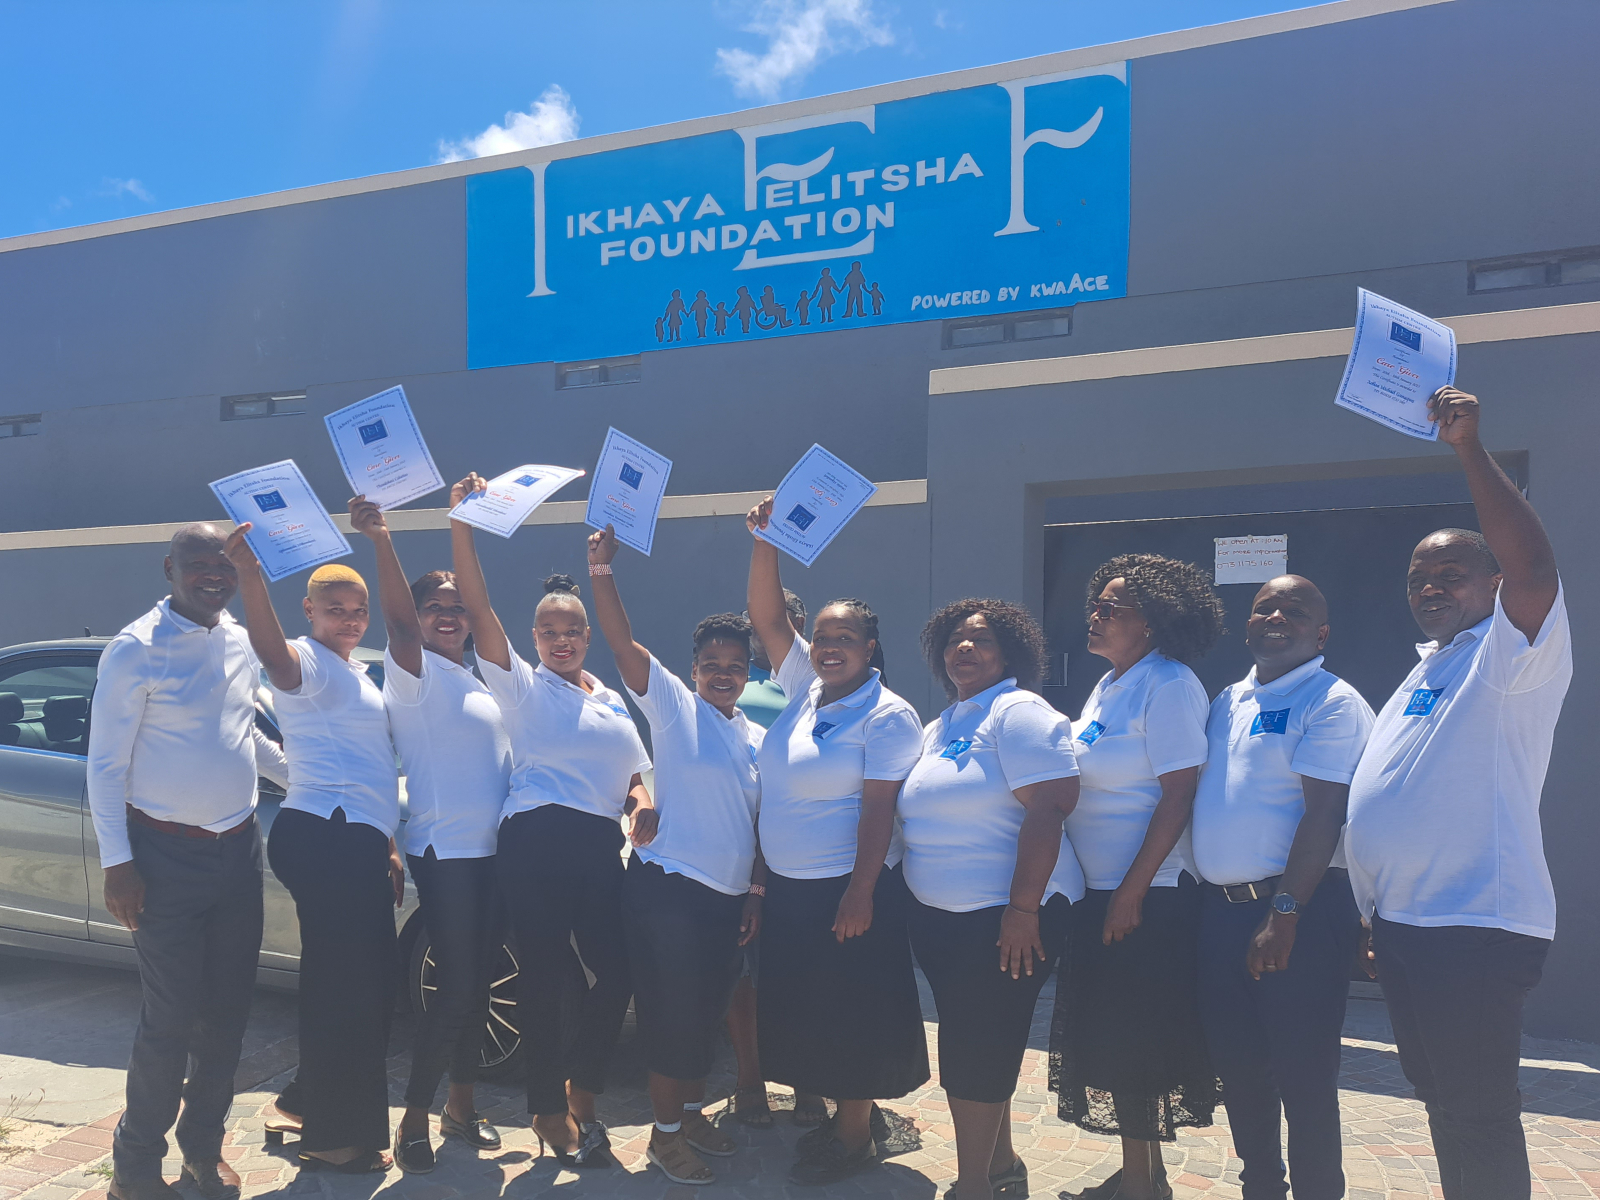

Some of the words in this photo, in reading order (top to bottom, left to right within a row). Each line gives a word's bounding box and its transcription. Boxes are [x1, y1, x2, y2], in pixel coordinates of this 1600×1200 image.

[566, 193, 726, 239] IKHAYA
[765, 152, 984, 210] ELITSHA
[600, 201, 895, 267] FOUNDATION
[910, 289, 991, 312] POWERED
[997, 286, 1020, 302] BY
[1216, 561, 1236, 570] 073
